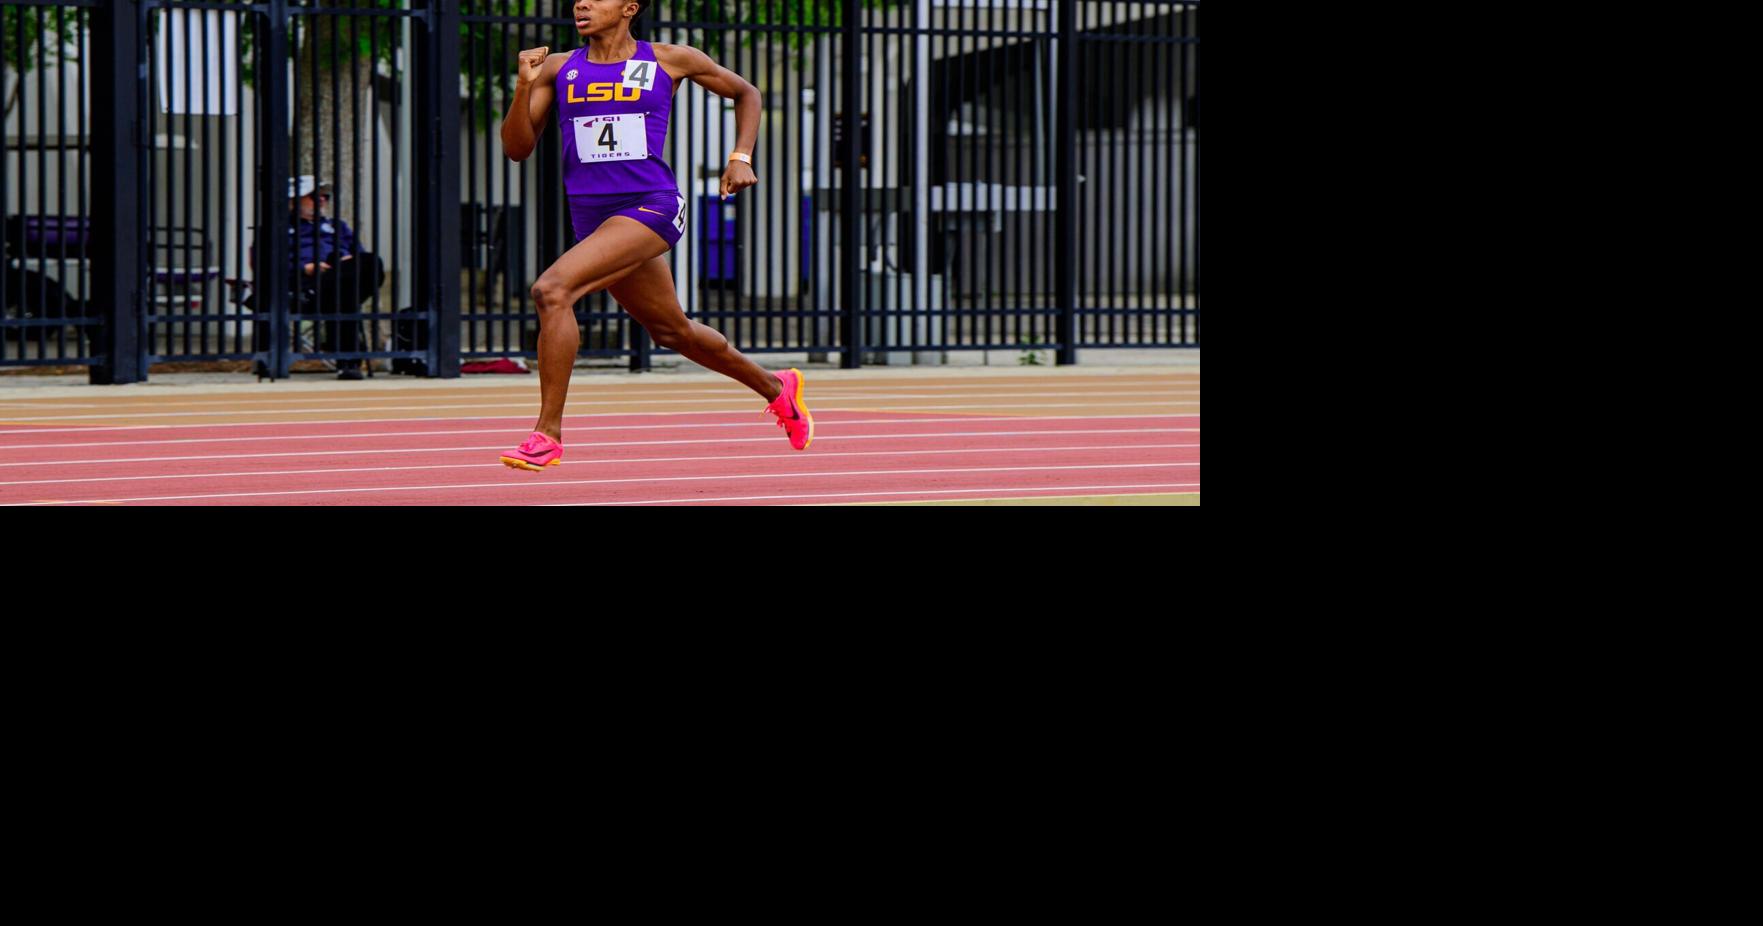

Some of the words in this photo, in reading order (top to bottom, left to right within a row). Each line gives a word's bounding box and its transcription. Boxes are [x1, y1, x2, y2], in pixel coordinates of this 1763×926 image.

[629, 62, 649, 87] 4
[567, 82, 641, 103] LSU
[598, 123, 617, 151] 4
